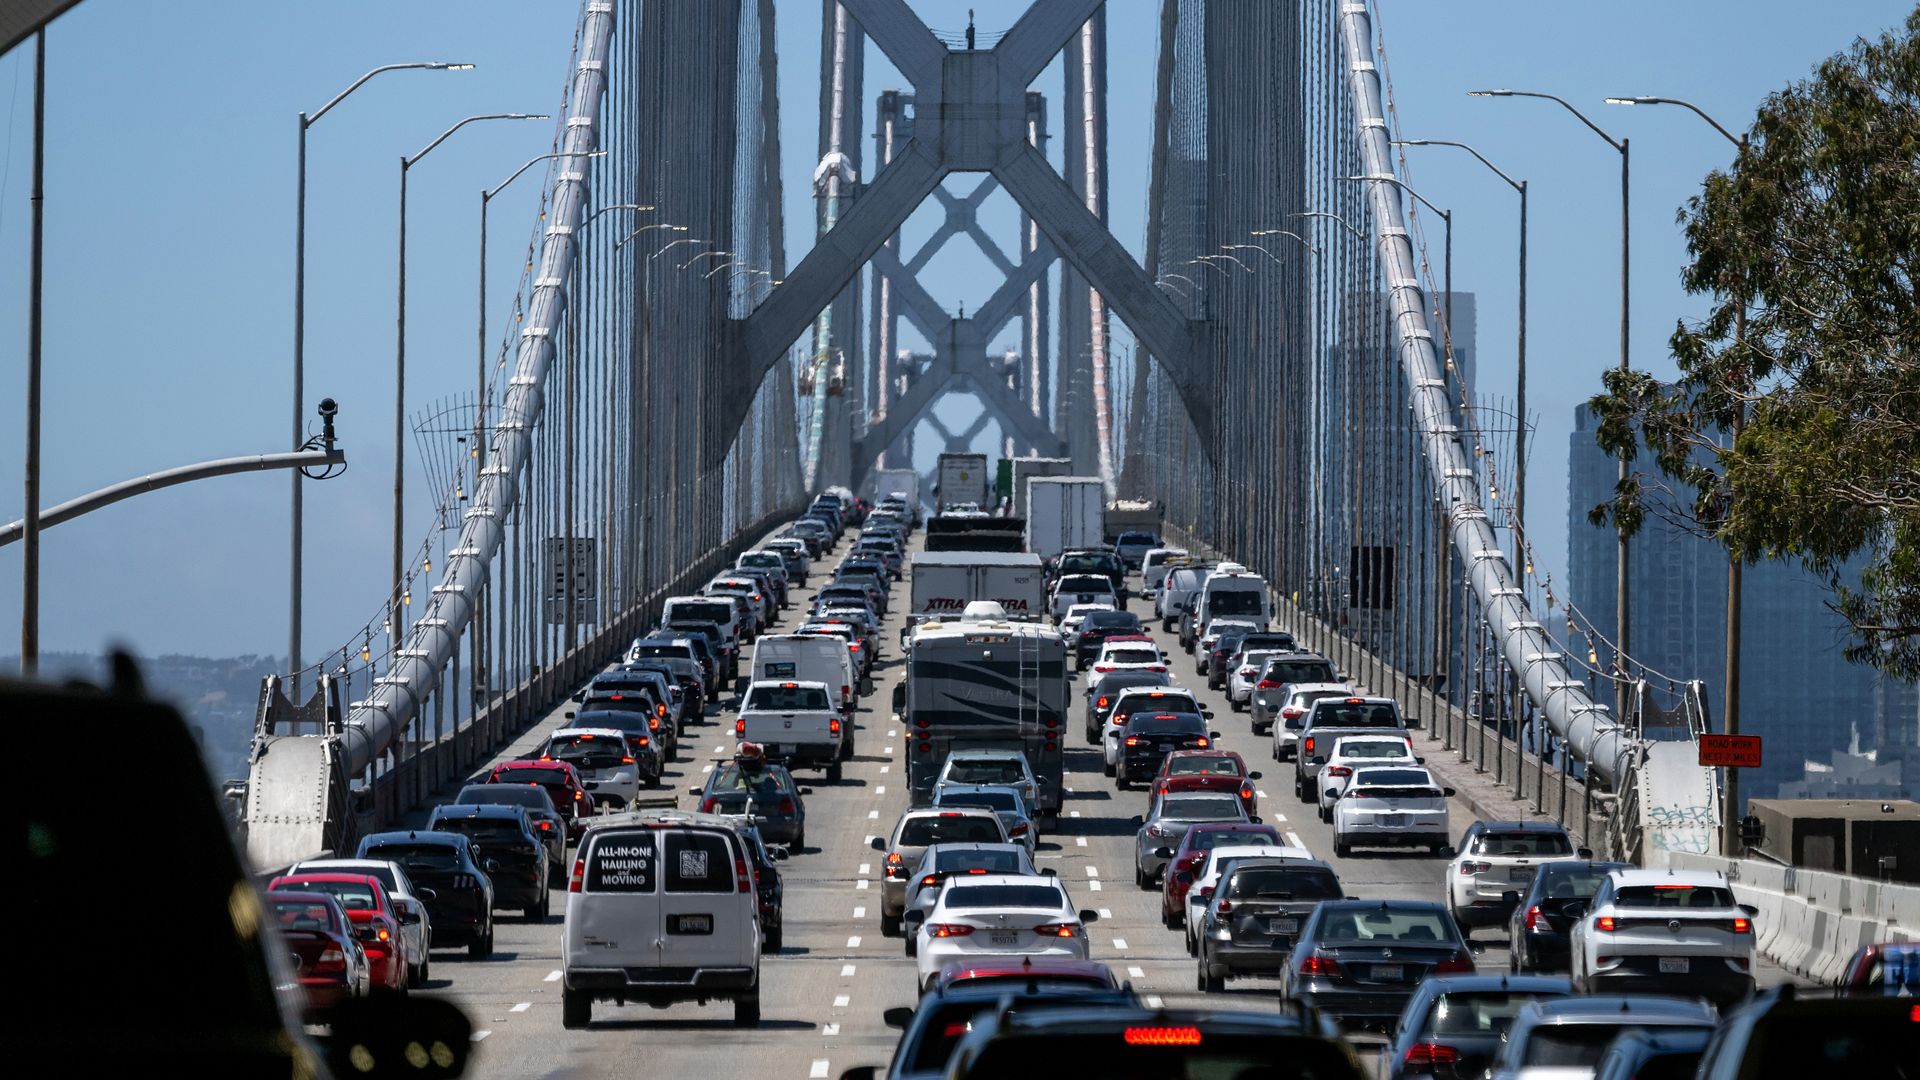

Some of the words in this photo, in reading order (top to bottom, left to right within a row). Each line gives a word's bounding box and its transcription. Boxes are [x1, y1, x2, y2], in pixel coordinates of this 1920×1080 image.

[923, 599, 965, 612] XTRA
[991, 599, 1028, 610] TRA
[1707, 739, 1729, 749] ROAD
[597, 847, 652, 858] ALL-IN-ONE
[601, 859, 647, 869] HAULING
[602, 875, 646, 885] MOVING
